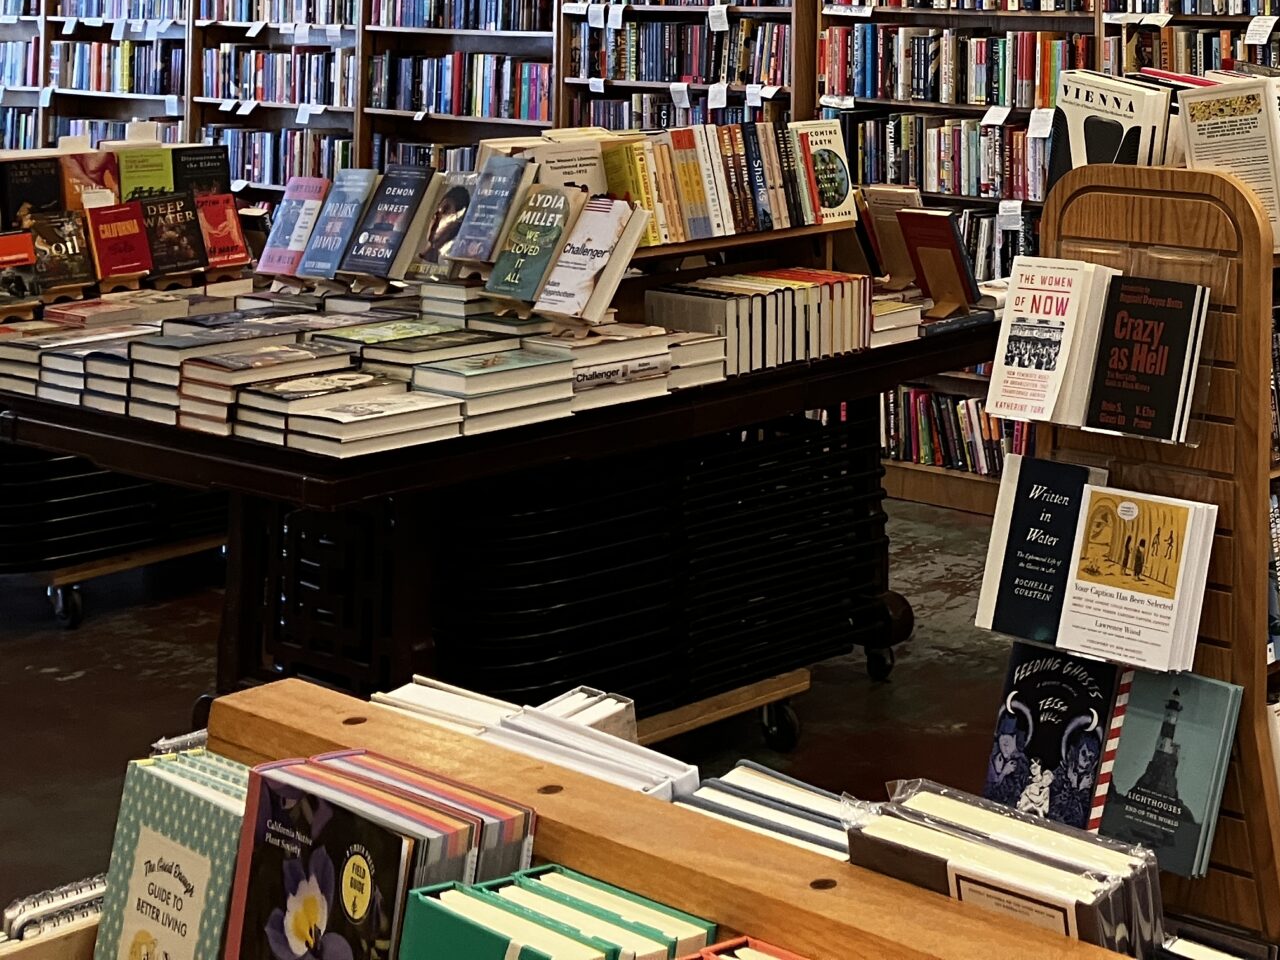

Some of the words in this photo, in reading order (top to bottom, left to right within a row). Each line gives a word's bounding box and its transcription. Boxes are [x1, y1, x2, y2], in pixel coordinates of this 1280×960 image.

[1063, 85, 1134, 113] VIENNA
[753, 160, 768, 201] Sharks
[386, 187, 415, 196] DEMON
[147, 201, 184, 216] DEEP
[529, 193, 565, 209] LYDIA
[143, 211, 195, 228] WATER
[518, 211, 563, 227] MILLET
[369, 235, 388, 243] ERIK
[526, 230, 539, 240] WE
[35, 235, 80, 260] Soil
[352, 246, 392, 259] LARSON
[511, 243, 540, 256] LOVED
[563, 242, 610, 259] Challenger
[515, 258, 524, 269] IT
[505, 273, 520, 283] ALL
[1019, 274, 1035, 285] THE
[1040, 276, 1073, 288] WOMEN
[1014, 296, 1025, 306] OF
[1030, 294, 1070, 317] NOW
[1114, 310, 1165, 350] Crazy
[1109, 346, 1129, 371] as
[1131, 342, 1169, 376] Hell
[576, 366, 621, 384] Challenger
[996, 401, 1027, 412] KATHERINE
[1028, 484, 1070, 506] Written
[1040, 508, 1051, 522] in
[1026, 528, 1060, 546] Water
[1014, 578, 1054, 592] ROCHELLE
[1015, 588, 1052, 601] GURSTEIN
[1074, 583, 1088, 592] Your
[1090, 587, 1114, 599] Caption
[1116, 591, 1128, 601] Has
[1129, 595, 1144, 605] Been
[1147, 600, 1173, 611] Selected
[1095, 620, 1123, 632] Lawrence
[1124, 626, 1141, 636] Wood
[1014, 656, 1061, 684] FEEDING
[1063, 661, 1103, 700] GHOSTS
[1039, 696, 1068, 712] TESSA
[1128, 792, 1181, 815] LIGHTHOUSES
[1159, 816, 1178, 826] WORLD
[266, 819, 295, 839] California
[295, 832, 313, 847] Native
[264, 833, 280, 849] Plant
[281, 839, 301, 858] Society
[144, 859, 156, 877] The
[156, 856, 174, 874] Good
[352, 861, 366, 877] FIELD
[349, 878, 365, 894] GUIDE
[147, 881, 171, 905] GUIDE
[172, 896, 184, 911] TO
[136, 897, 161, 922] BETTER
[160, 913, 188, 937] LIVING
